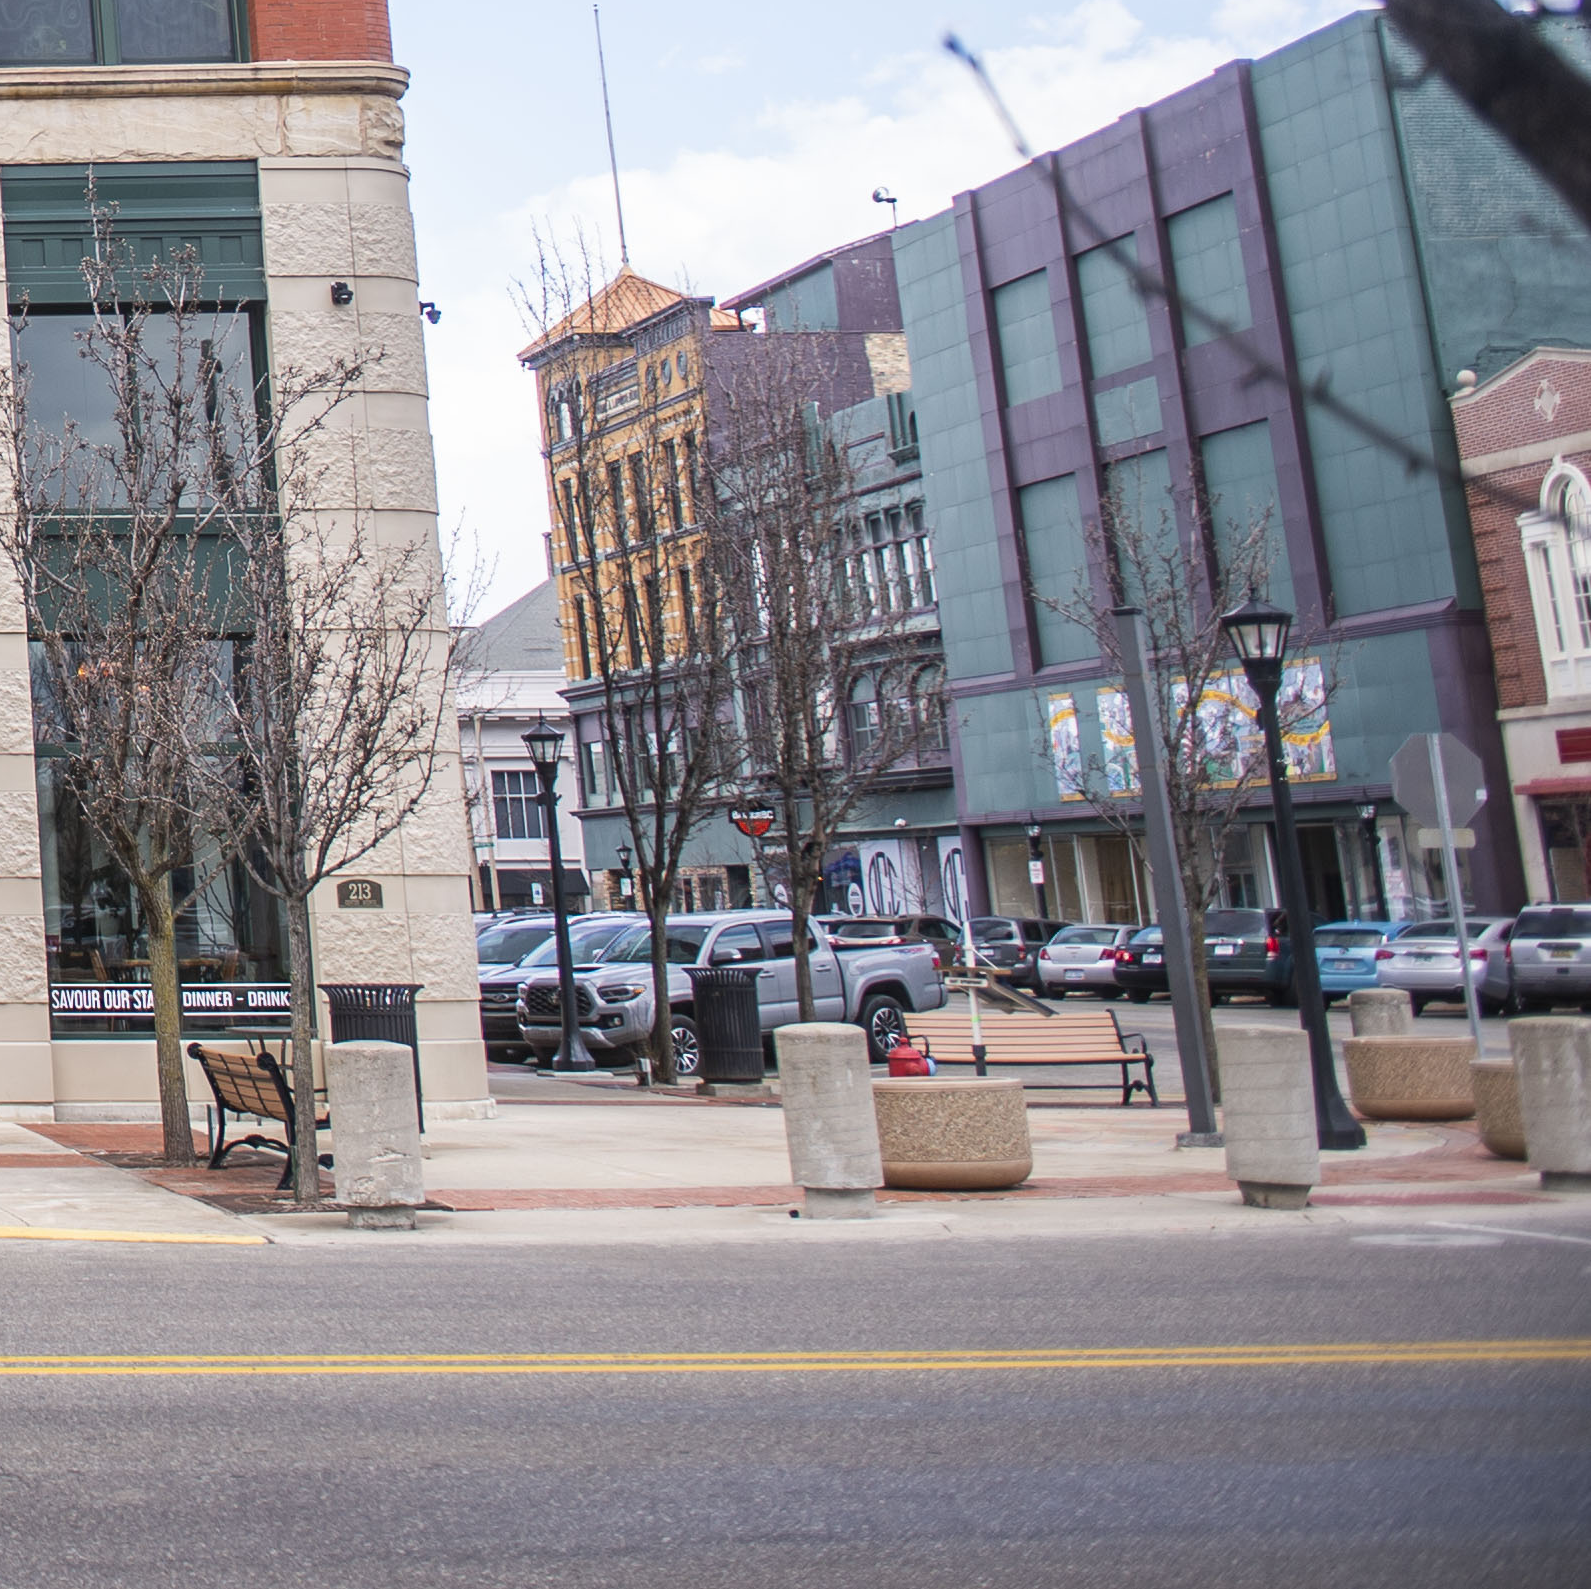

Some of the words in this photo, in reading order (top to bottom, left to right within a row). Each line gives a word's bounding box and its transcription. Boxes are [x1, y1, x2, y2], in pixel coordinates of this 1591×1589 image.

[348, 882, 372, 900] 213
[51, 989, 100, 1009] SAVOUR
[103, 989, 131, 1009] OUR
[133, 989, 155, 1009] STA
[182, 990, 233, 1007] DINNER
[248, 990, 292, 1008] DRINK
